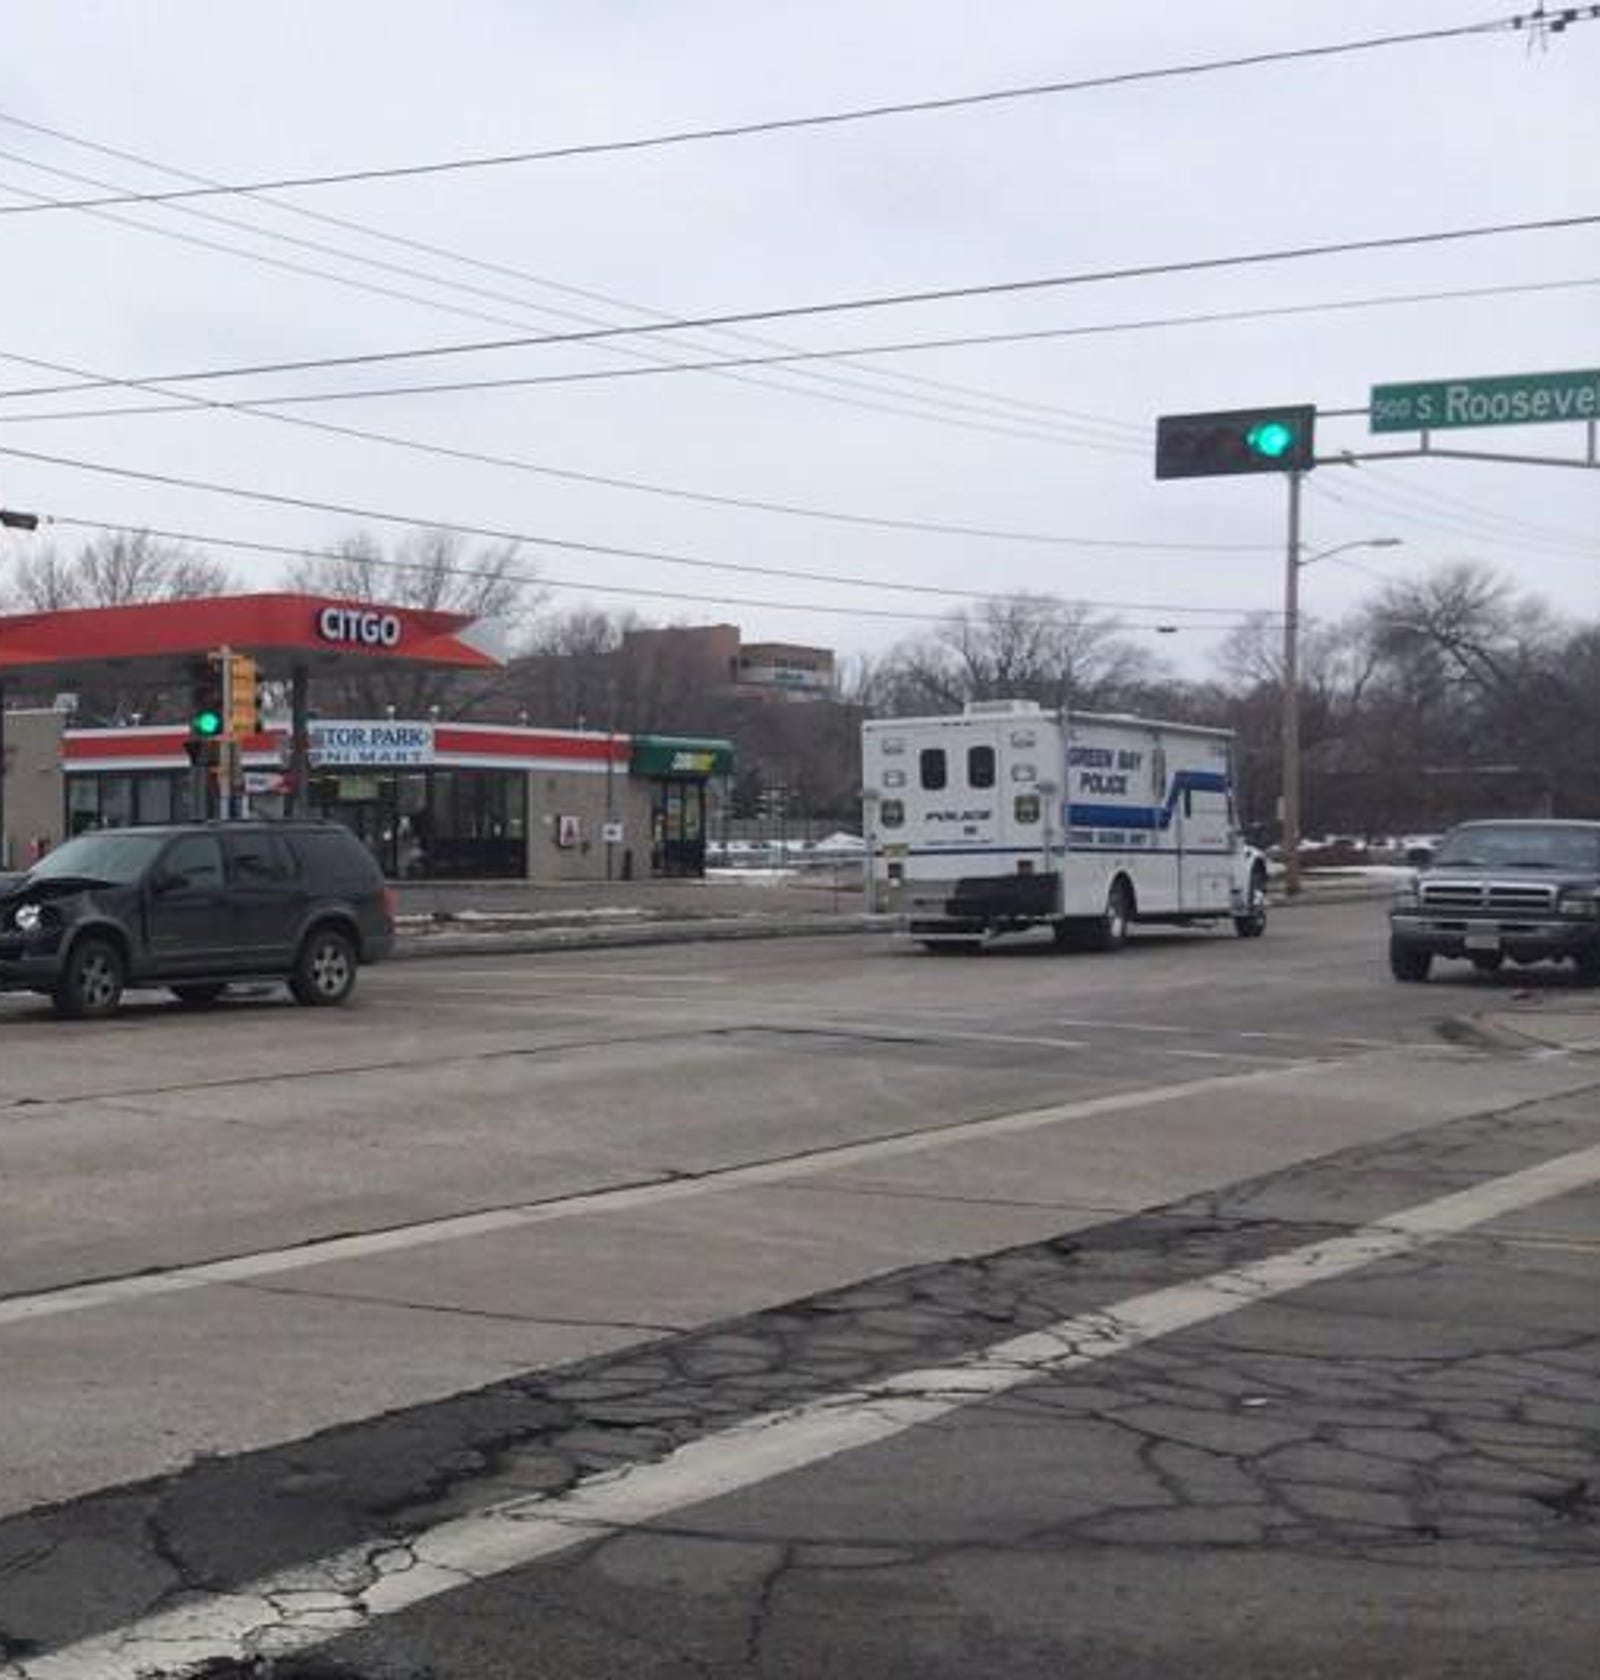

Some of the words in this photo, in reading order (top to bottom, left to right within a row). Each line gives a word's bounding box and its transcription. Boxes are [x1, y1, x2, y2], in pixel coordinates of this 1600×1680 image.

[320, 607, 401, 646] CITGO
[371, 727, 425, 748] PARK
[1066, 747, 1113, 768] GREEN
[1118, 750, 1143, 771] BAY
[1080, 772, 1128, 796] POLICE
